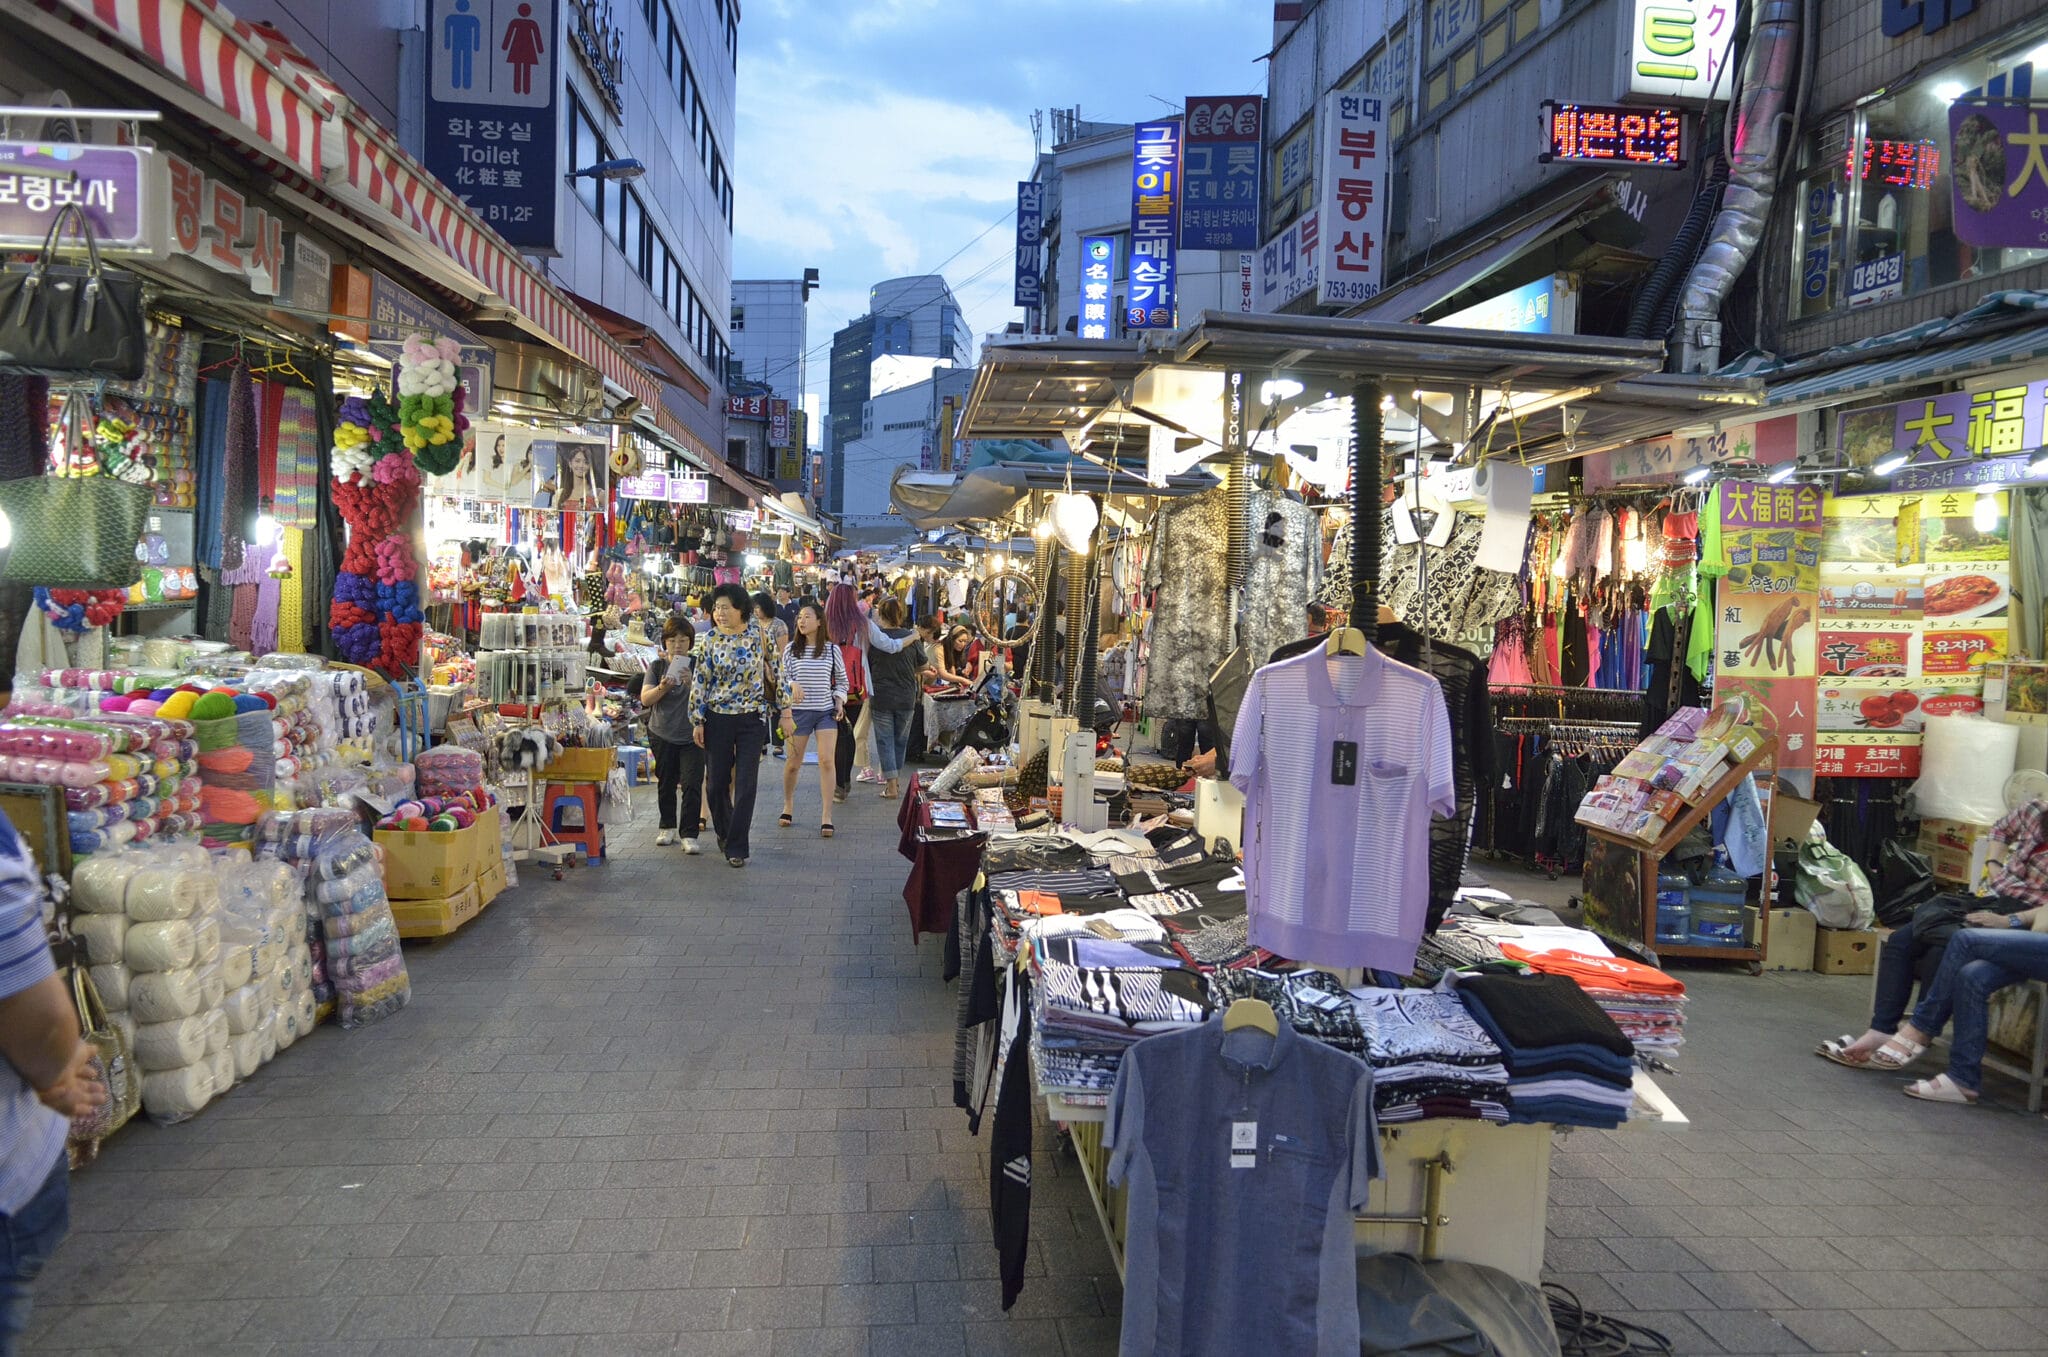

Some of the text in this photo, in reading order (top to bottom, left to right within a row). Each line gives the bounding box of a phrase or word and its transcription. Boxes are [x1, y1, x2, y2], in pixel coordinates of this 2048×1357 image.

[1340, 97, 1381, 122] 현대
[448, 118, 532, 142] 화장실
[458, 144, 520, 166] Toilet
[1186, 147, 1256, 175] 그릇
[455, 167, 523, 188] 化粧室
[1188, 180, 1255, 200] 도매상가
[1335, 128, 1376, 272] 부동산
[1017, 184, 1041, 302] 삼성까운
[1853, 256, 1900, 292] 대성안경
[732, 398, 760, 414] 안경
[1904, 385, 2048, 460] 大福
[1727, 484, 1819, 523] 大福商会
[1748, 575, 1798, 593] やきのり
[1854, 762, 1907, 774] チョコレート
